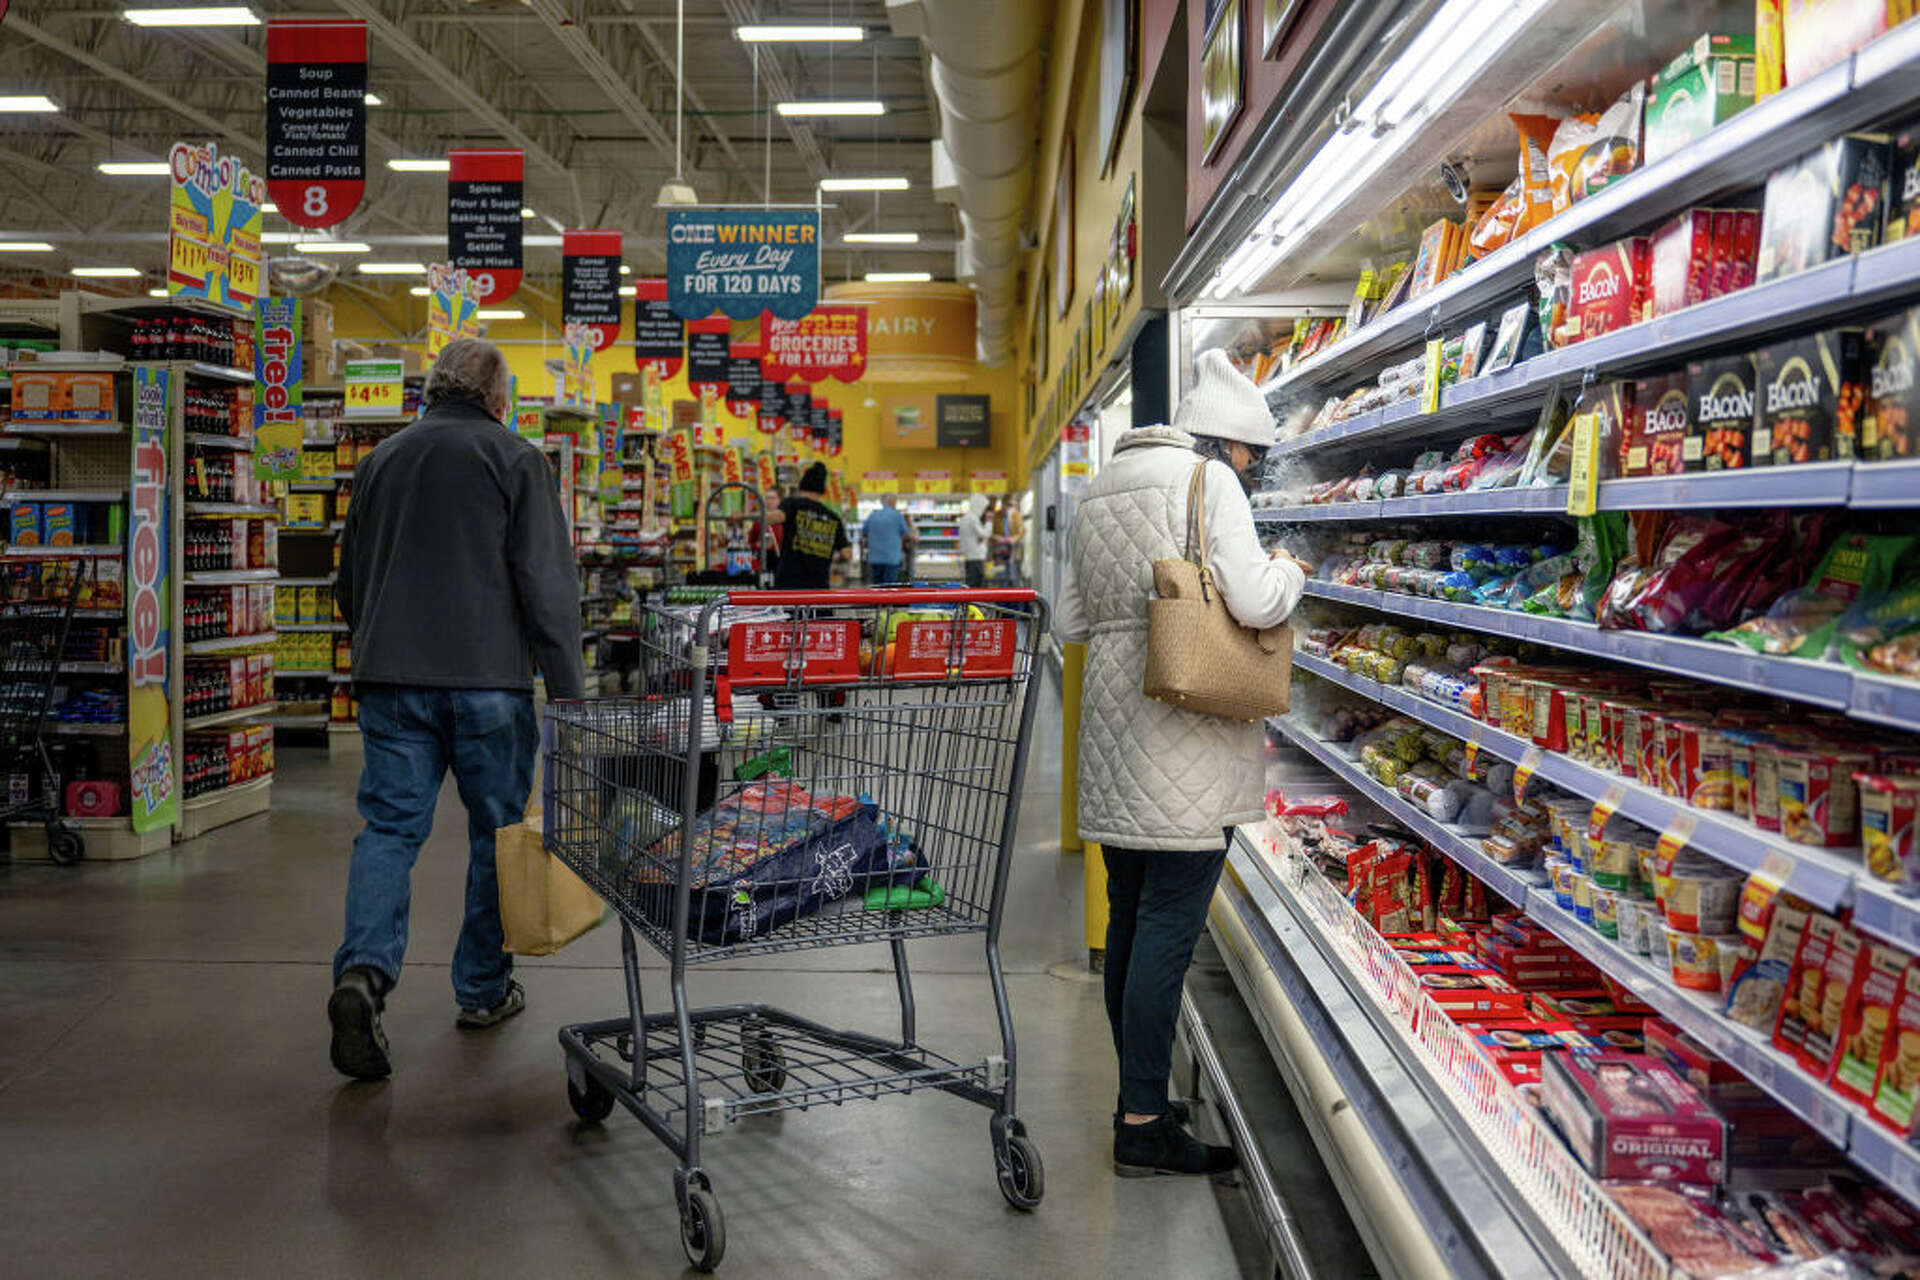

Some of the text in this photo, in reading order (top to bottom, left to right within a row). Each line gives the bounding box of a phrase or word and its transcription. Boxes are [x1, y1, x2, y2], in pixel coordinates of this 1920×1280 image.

[299, 67, 333, 80] Soup
[269, 87, 363, 98] Canned Beans
[279, 106, 353, 120] Vegetables
[281, 123, 318, 132] Canned
[274, 145, 359, 156] Canned Chili
[171, 143, 231, 197] Combo
[270, 164, 361, 176] Canned Pasta
[468, 184, 502, 195] Spices
[303, 185, 328, 217] 8
[450, 199, 477, 208] Flour
[491, 199, 520, 210] Sugar
[451, 213, 520, 223] Baking Needs
[671, 224, 815, 244] ONE WINNER
[466, 242, 504, 252] Gelatin
[457, 257, 514, 267] Cake Mixes
[696, 244, 794, 272] Every Day
[477, 273, 495, 297] 9
[684, 275, 802, 294] FOR 120 DAYS
[1578, 275, 1620, 304] BACON
[800, 314, 858, 335] FREE
[770, 335, 858, 352] GROCERIES
[779, 353, 849, 366] FOR A YEAR!
[263, 325, 295, 423] free!
[1766, 376, 1821, 413] BACON
[1698, 391, 1755, 422] BACON
[137, 409, 167, 429] what's
[1644, 409, 1687, 434] BACO
[604, 419, 618, 471] free!
[131, 435, 167, 687] free!
[1612, 1140, 1714, 1158] ORIGINAL
